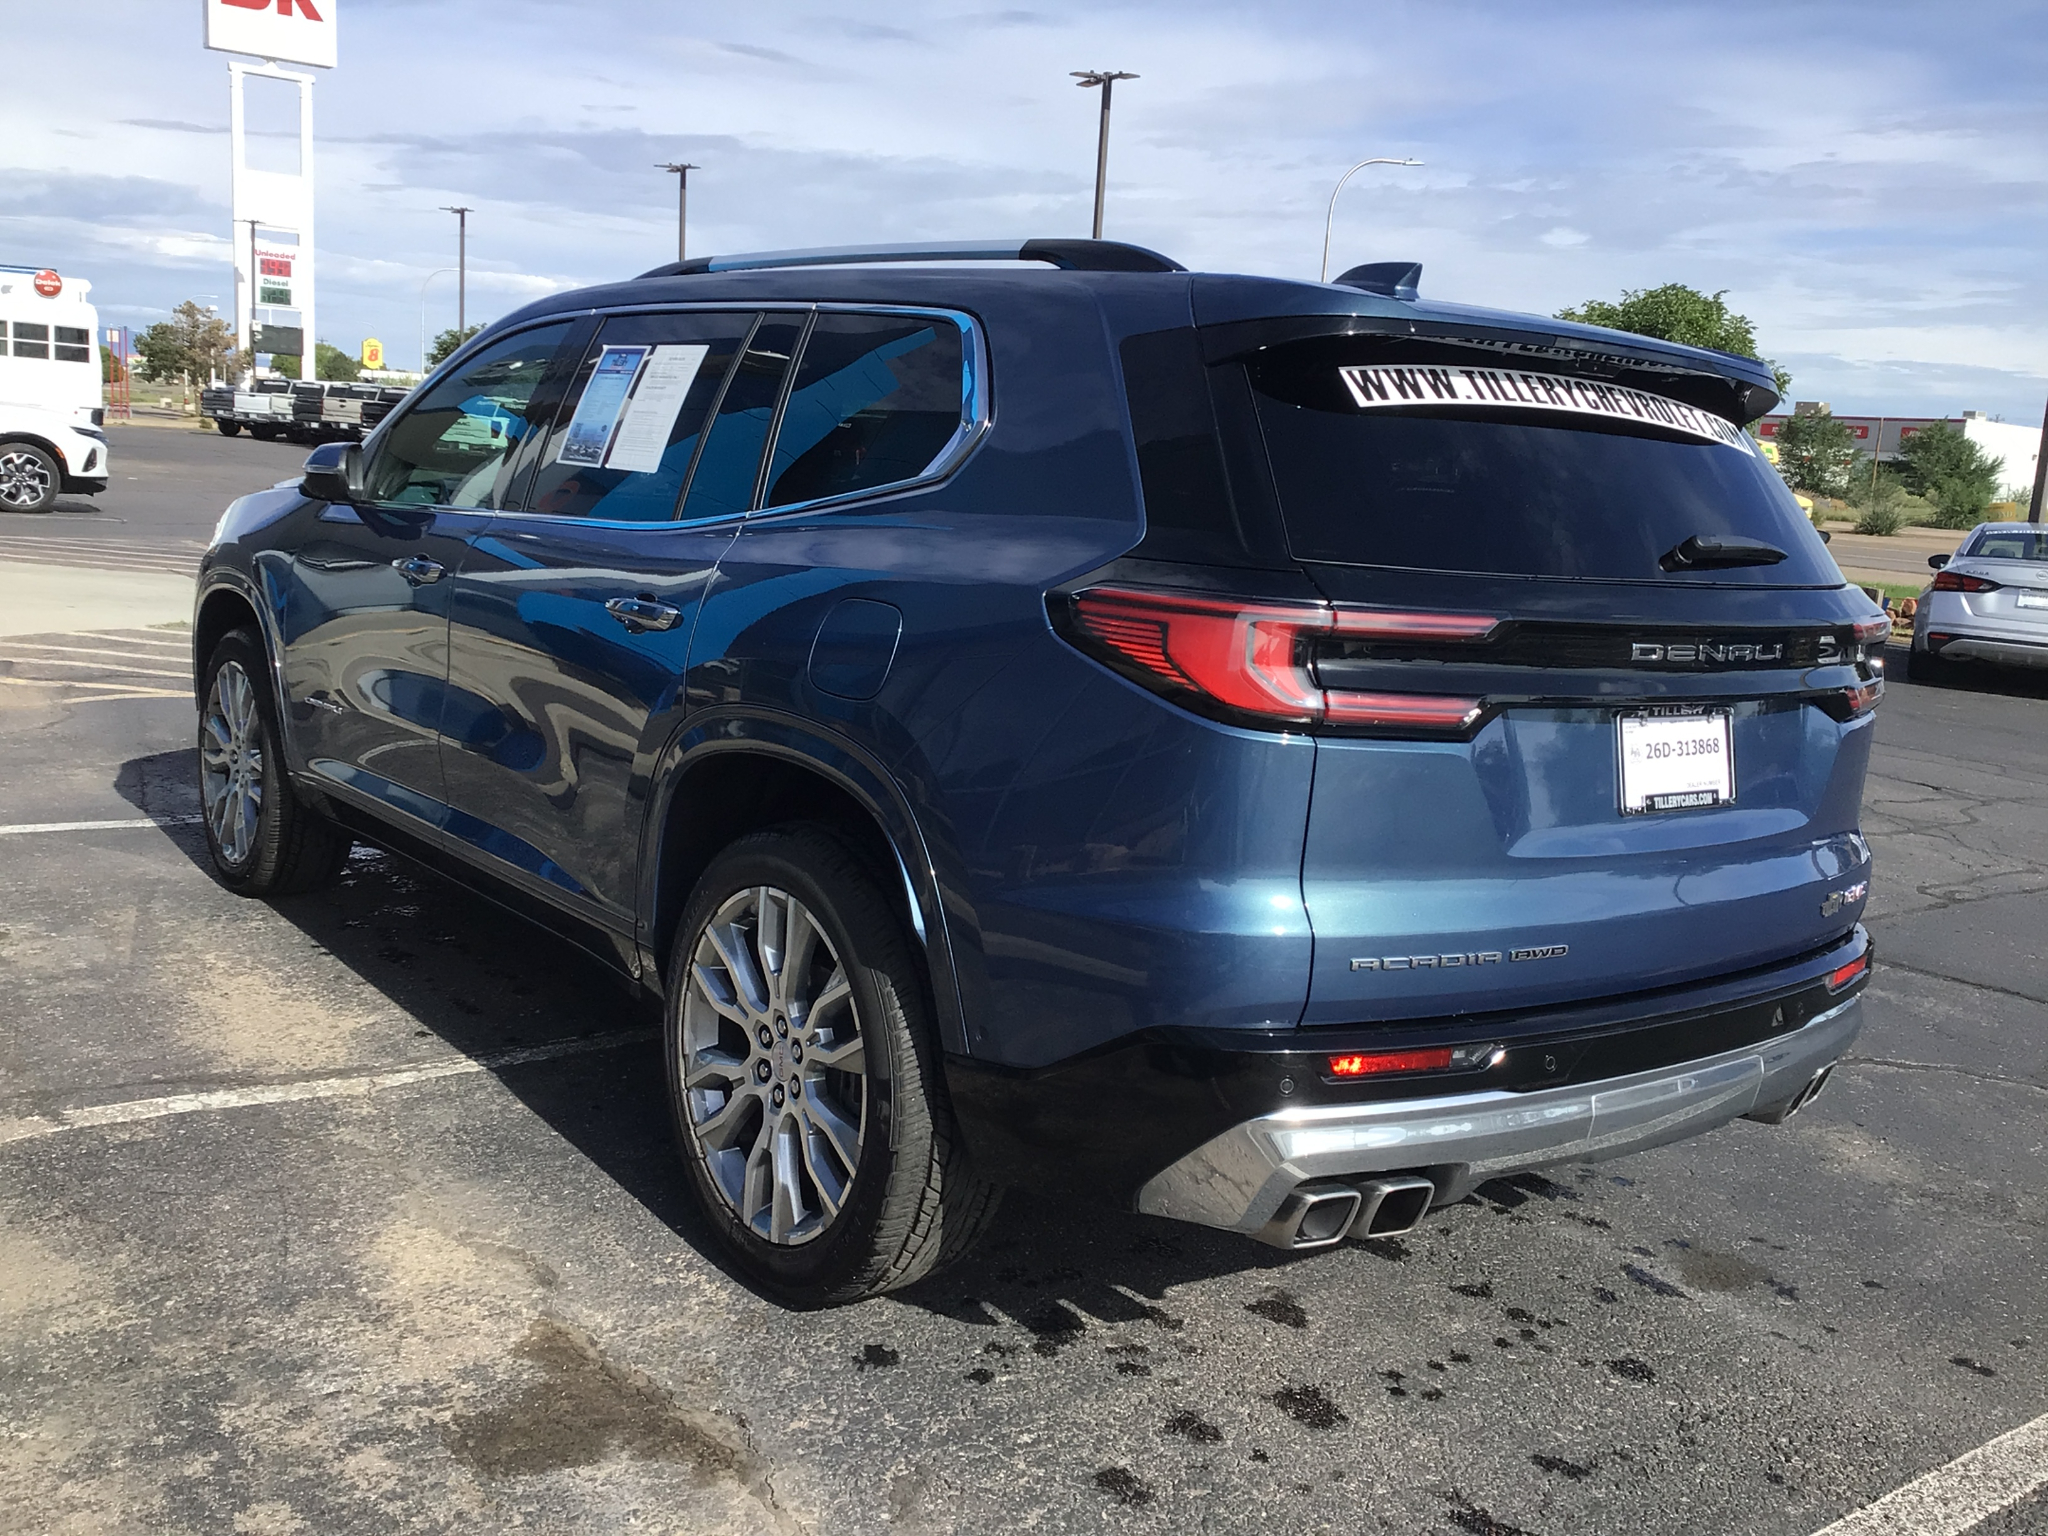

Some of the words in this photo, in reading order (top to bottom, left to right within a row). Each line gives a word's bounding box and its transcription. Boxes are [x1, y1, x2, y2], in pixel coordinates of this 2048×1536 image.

[254, 249, 296, 260] Unleaded
[263, 278, 289, 287] Diesel
[368, 348, 379, 361] 8
[1348, 367, 1752, 453] WWW.TILLERYCHEVROLET.COM
[1631, 643, 1783, 662] DENALI
[1645, 738, 1720, 760] 26D-313868
[1653, 792, 1713, 810] TILLERYCARS.COM
[1350, 951, 1503, 973] ACADIA
[1512, 945, 1569, 962] AWD
